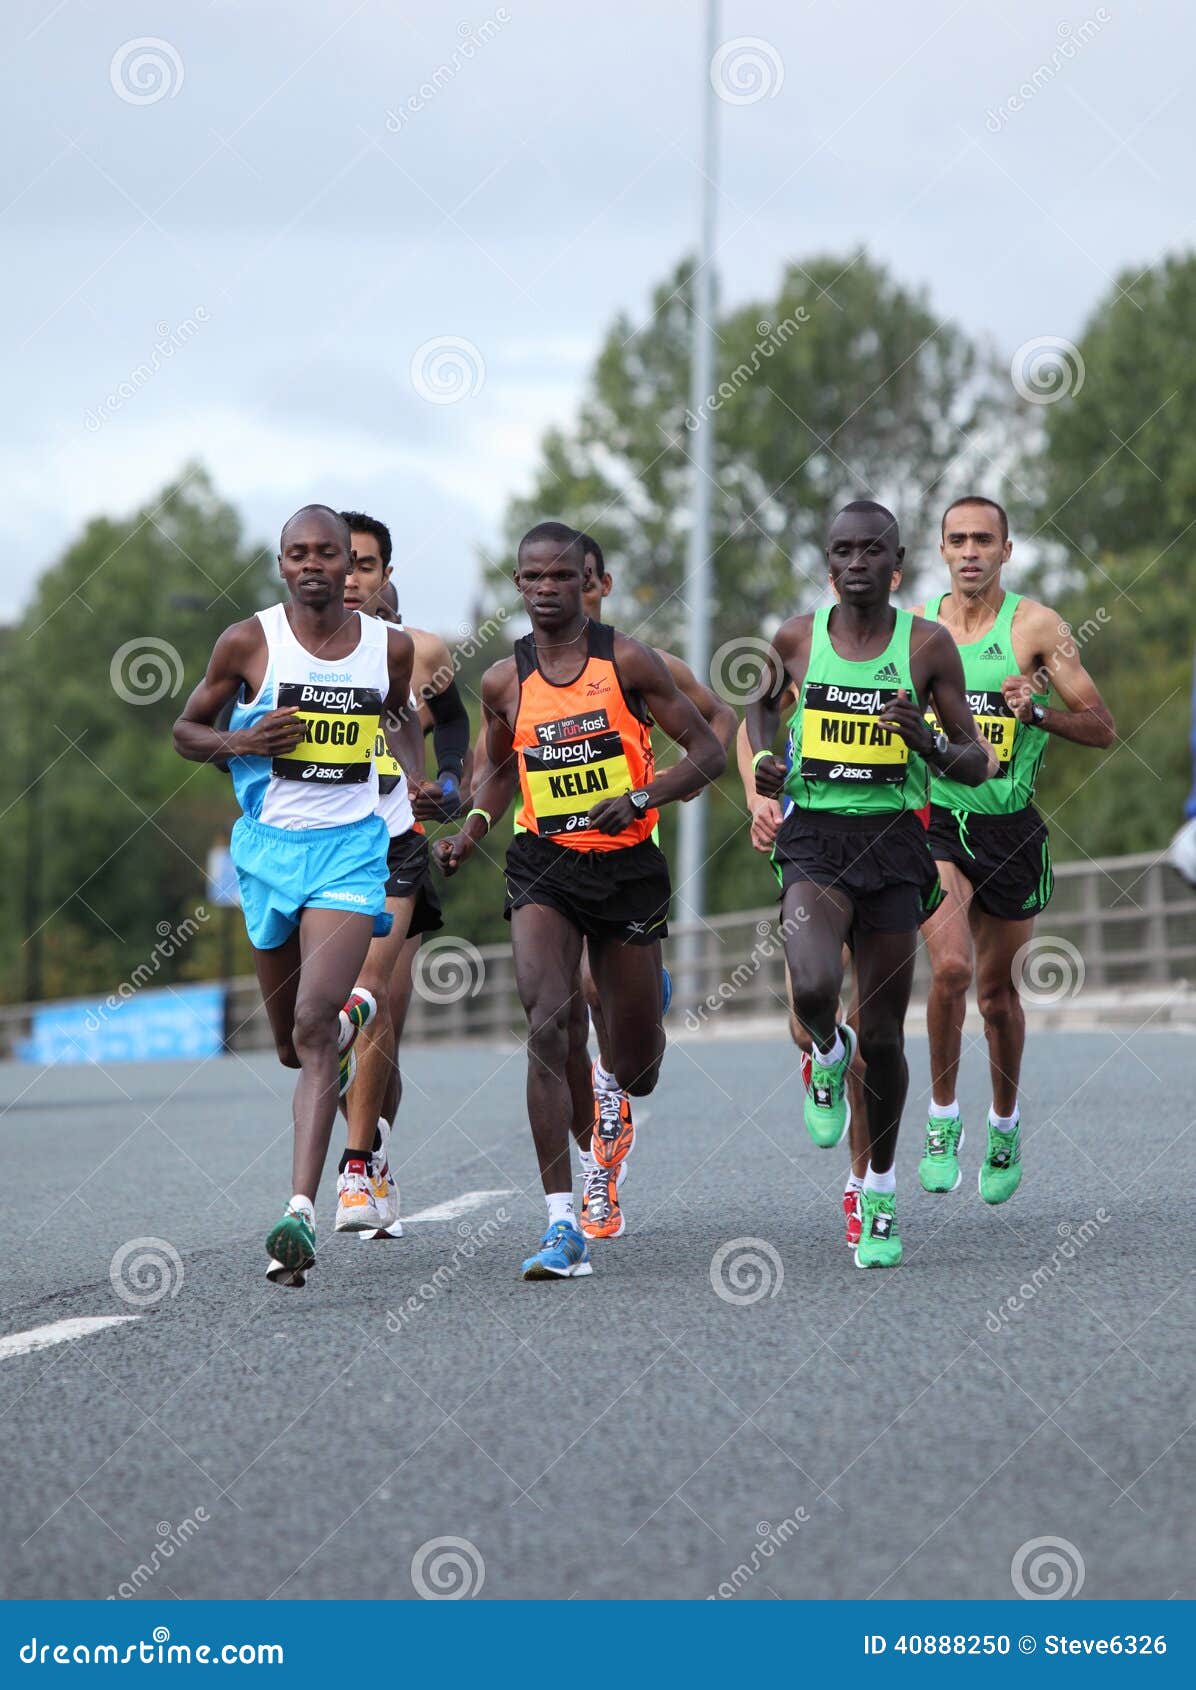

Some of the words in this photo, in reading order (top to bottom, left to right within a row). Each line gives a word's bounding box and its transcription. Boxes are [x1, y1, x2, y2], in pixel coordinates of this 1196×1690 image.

[309, 671, 352, 683] Reebok
[301, 686, 352, 709] Bupa
[826, 686, 876, 709] Bupa
[561, 719, 575, 727] team
[563, 716, 606, 736] run-fast
[302, 719, 360, 746] KOGO
[365, 749, 371, 759] 5
[542, 744, 586, 763] Bupa
[899, 750, 905, 760] 1
[1002, 749, 1009, 758] 3
[392, 761, 398, 771] 8
[316, 767, 344, 779] asics
[842, 767, 872, 780] asics
[548, 767, 609, 798] KELAI
